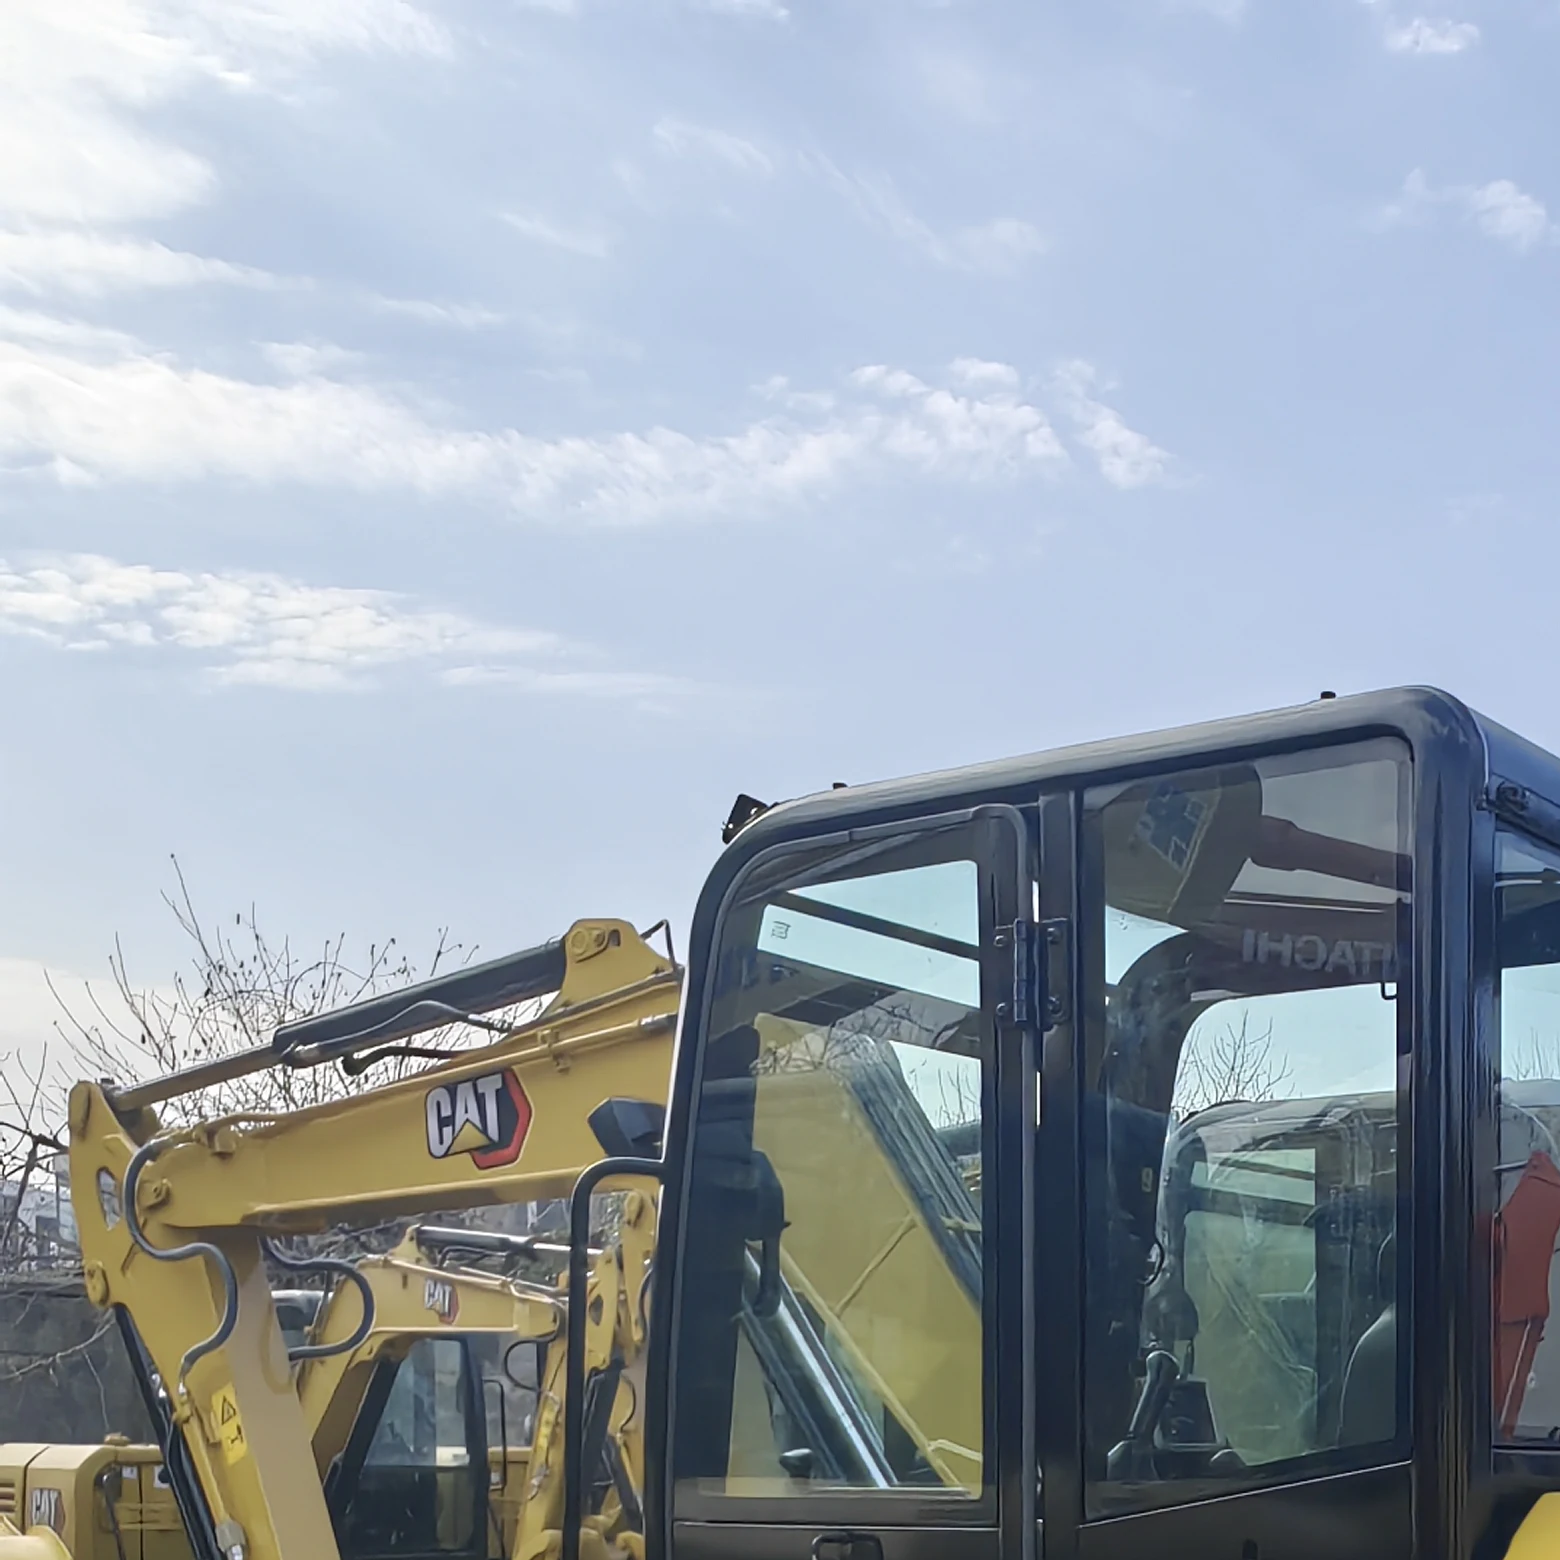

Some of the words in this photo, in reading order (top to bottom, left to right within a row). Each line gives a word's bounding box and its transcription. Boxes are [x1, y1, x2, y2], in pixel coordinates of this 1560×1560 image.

[426, 1073, 503, 1158] CAT
[425, 1280, 452, 1312] CAT
[32, 1489, 59, 1527] CAT
